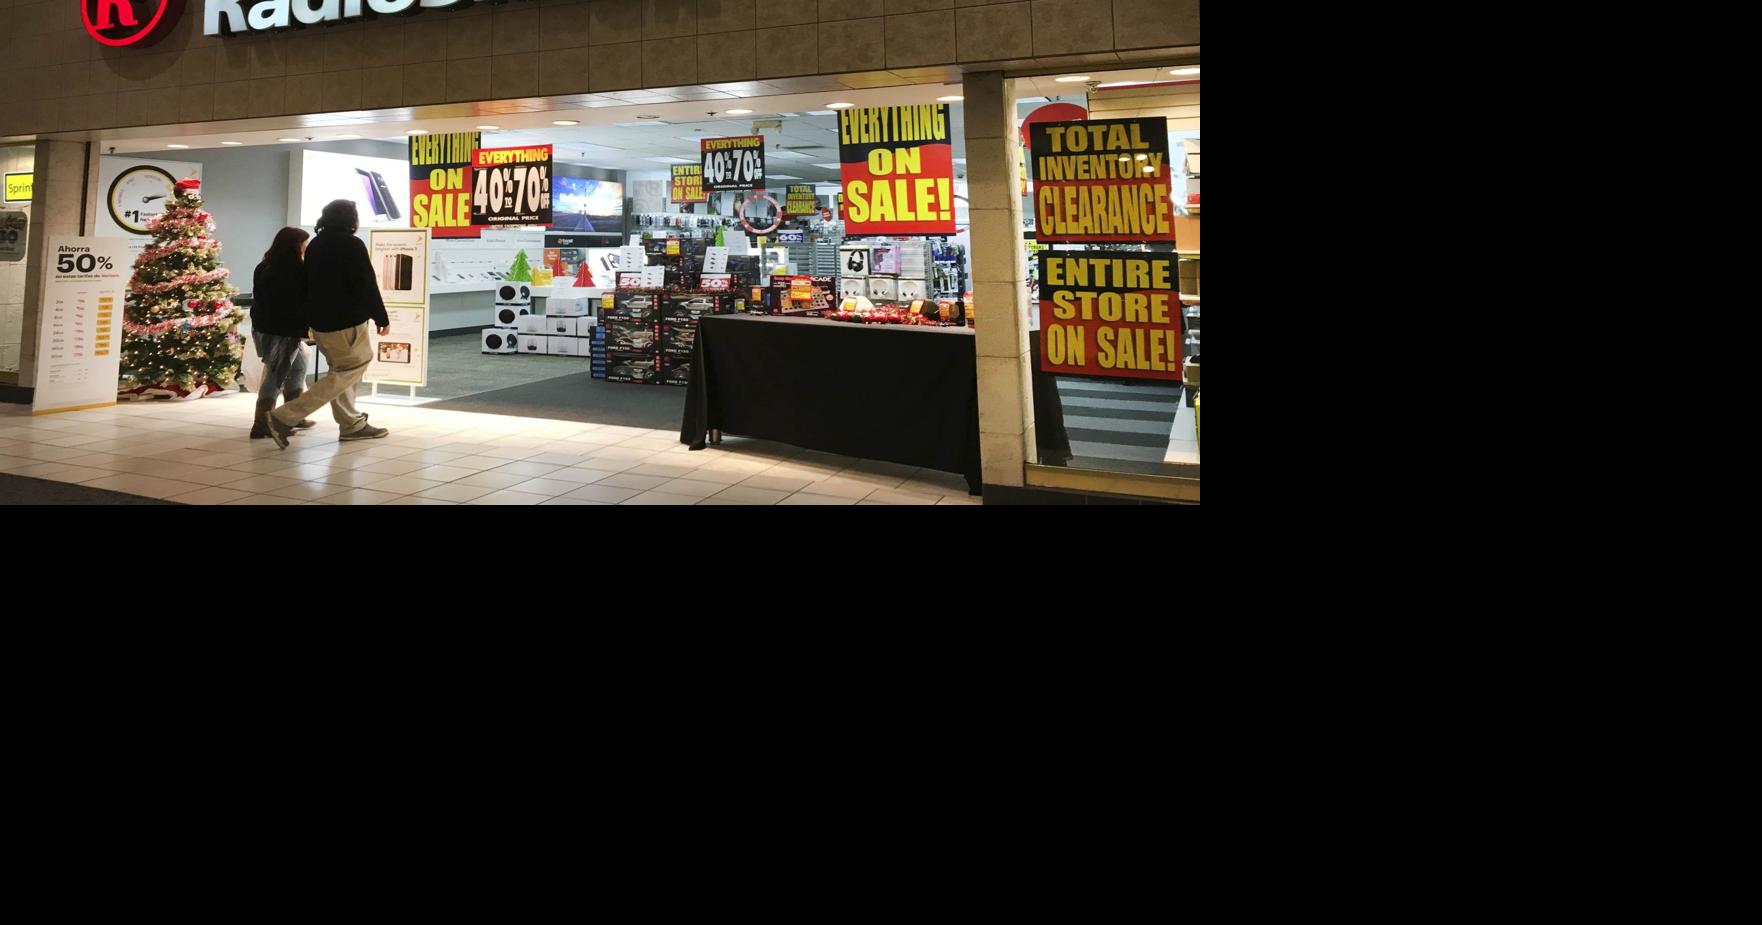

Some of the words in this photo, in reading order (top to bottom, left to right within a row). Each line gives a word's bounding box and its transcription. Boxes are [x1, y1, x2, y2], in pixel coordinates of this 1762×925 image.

[841, 103, 946, 144] EVERYTHING
[705, 137, 760, 150] EVERYTHING
[1046, 124, 1150, 153] TOTAL
[478, 148, 549, 165] EVERYTHING
[673, 165, 702, 176] ENTIR
[868, 147, 921, 176] ON
[1039, 153, 1163, 181] INVENTORY
[429, 167, 463, 191] ON
[473, 167, 514, 215] 40%
[504, 196, 513, 208] TO
[513, 165, 549, 214] 70%
[674, 176, 702, 186] STOR
[846, 178, 951, 223] SALE!
[1039, 183, 1170, 236] CLEARANCE
[125, 210, 140, 223] #1
[56, 254, 113, 274] 50%
[1046, 258, 1172, 289] ENTIRE
[1052, 290, 1171, 324] STORE
[1047, 323, 1086, 366] ON
[1096, 326, 1176, 372] SALE!
